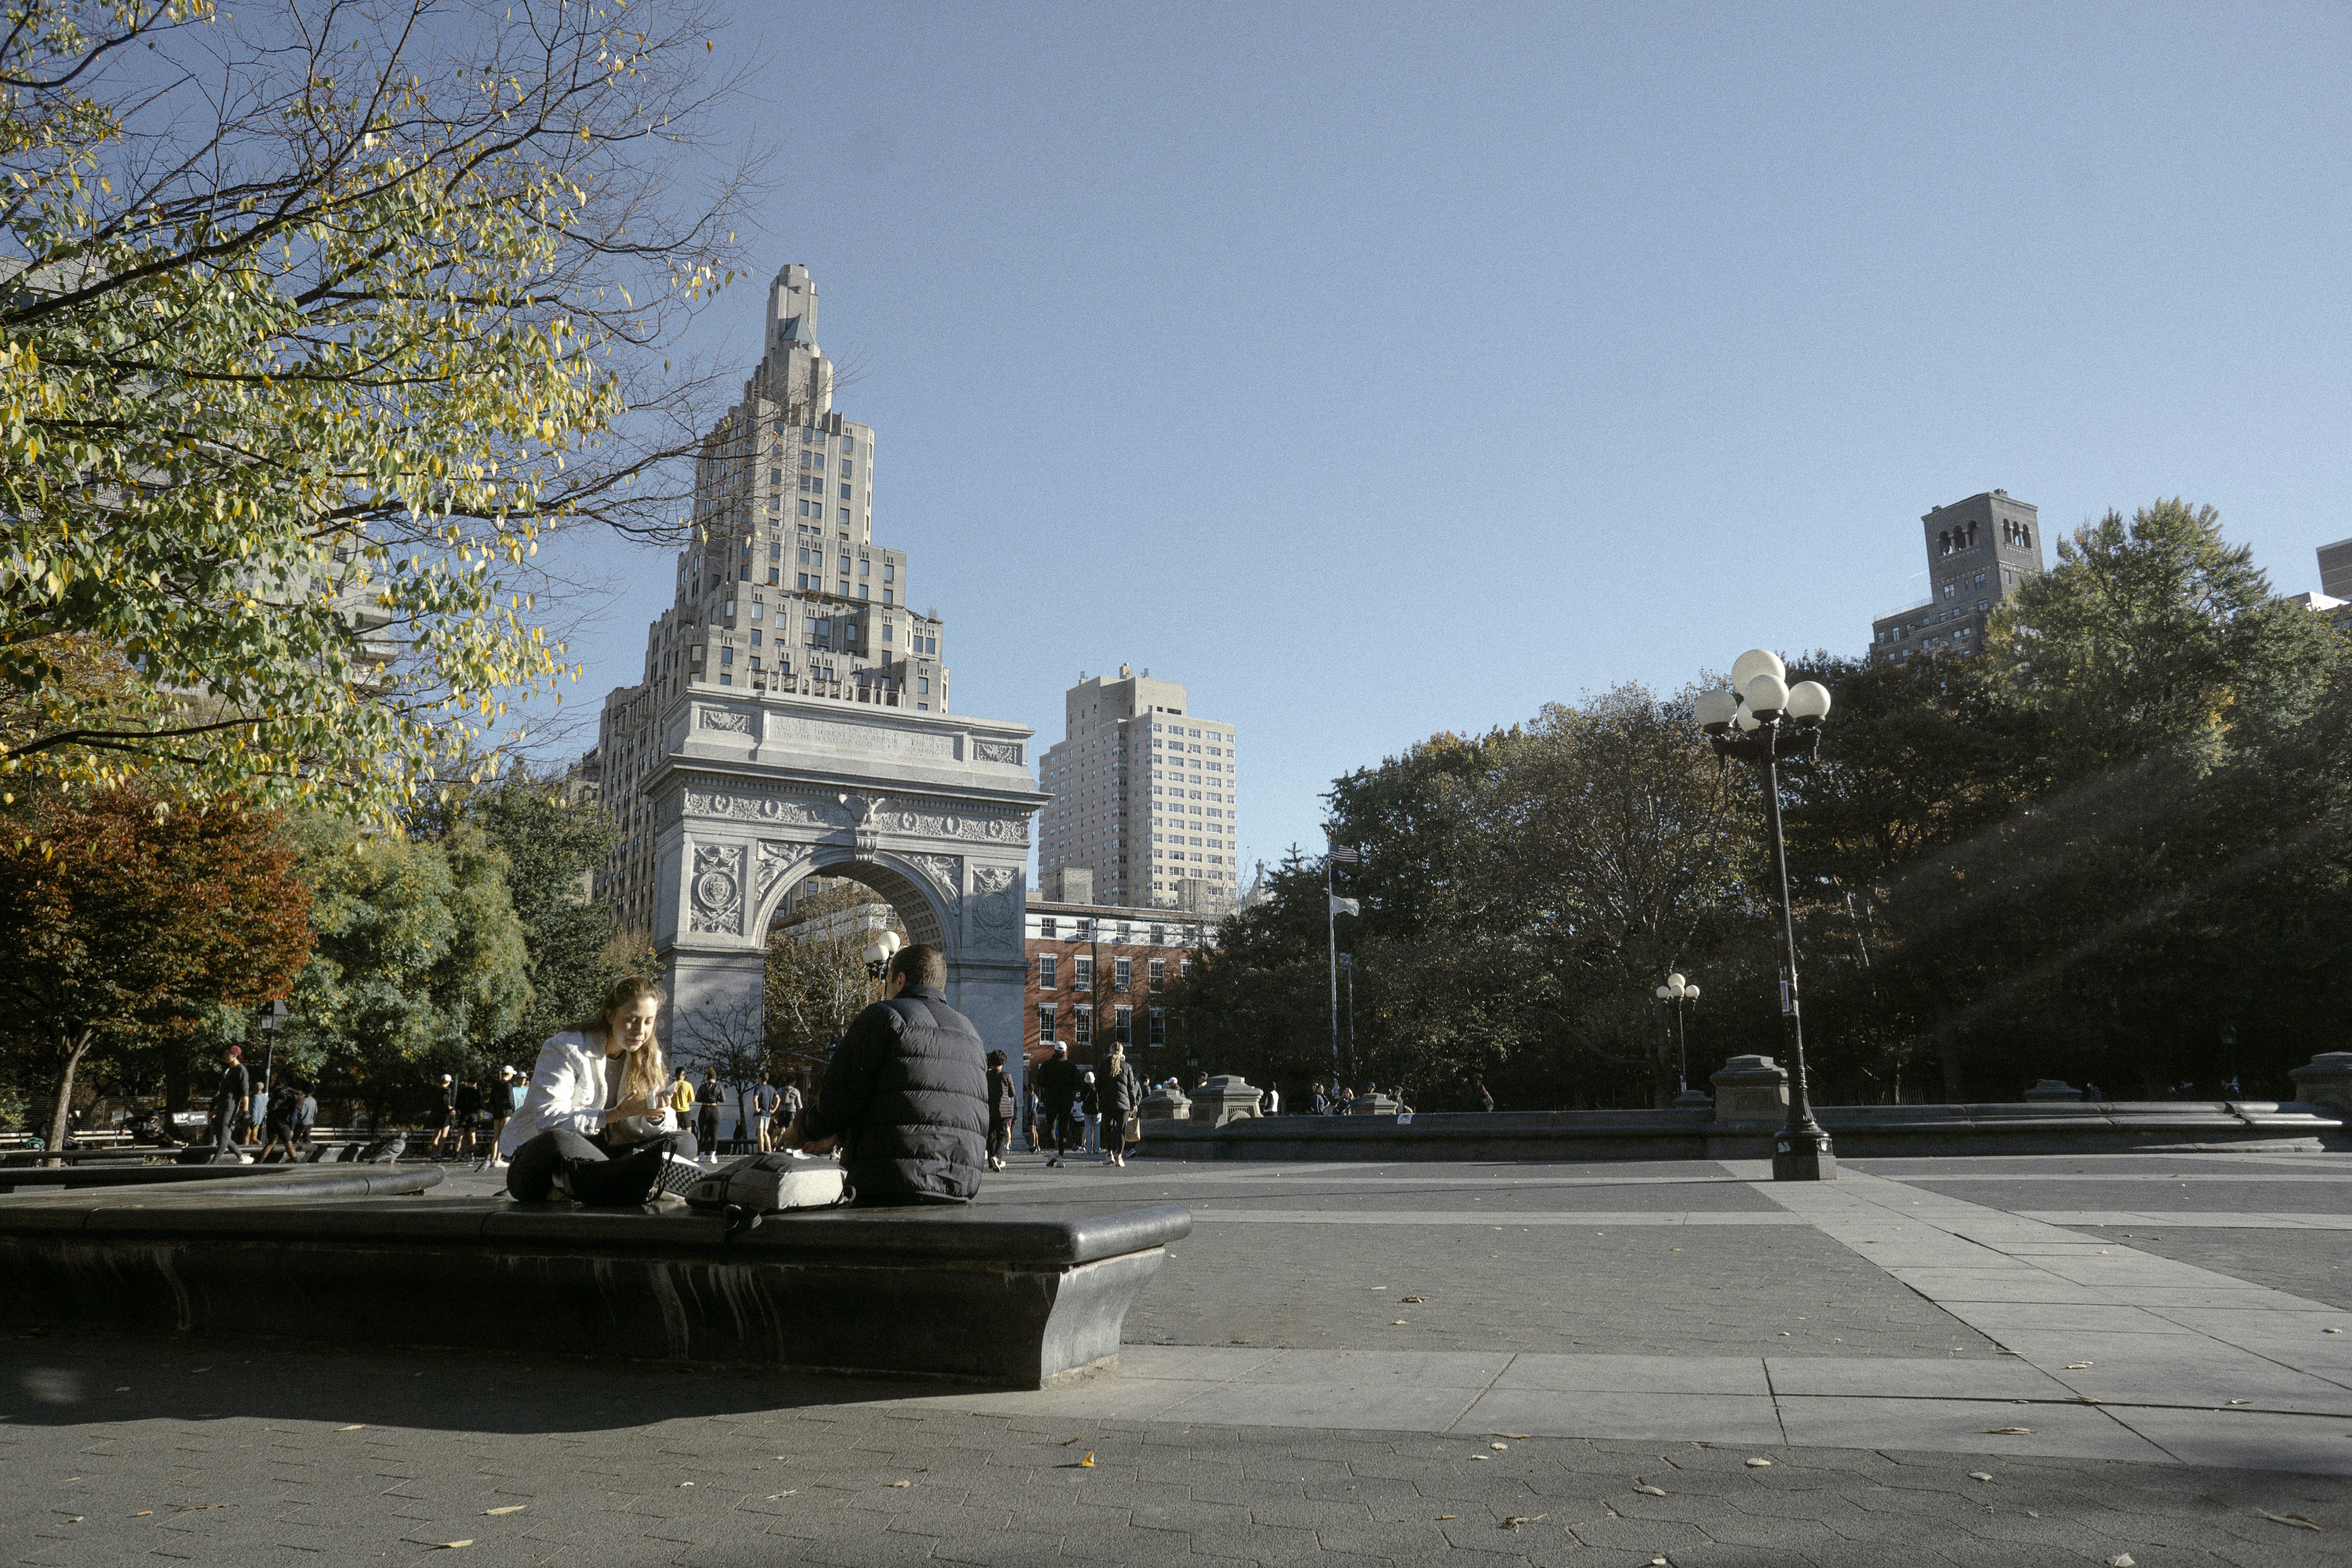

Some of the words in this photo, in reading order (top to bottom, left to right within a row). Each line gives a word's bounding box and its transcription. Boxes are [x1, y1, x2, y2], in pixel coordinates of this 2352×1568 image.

[837, 725, 878, 735] STANDARD
[814, 729, 846, 738] HONEST
[871, 735, 898, 744] REPAIR
[815, 735, 838, 744] HAND
